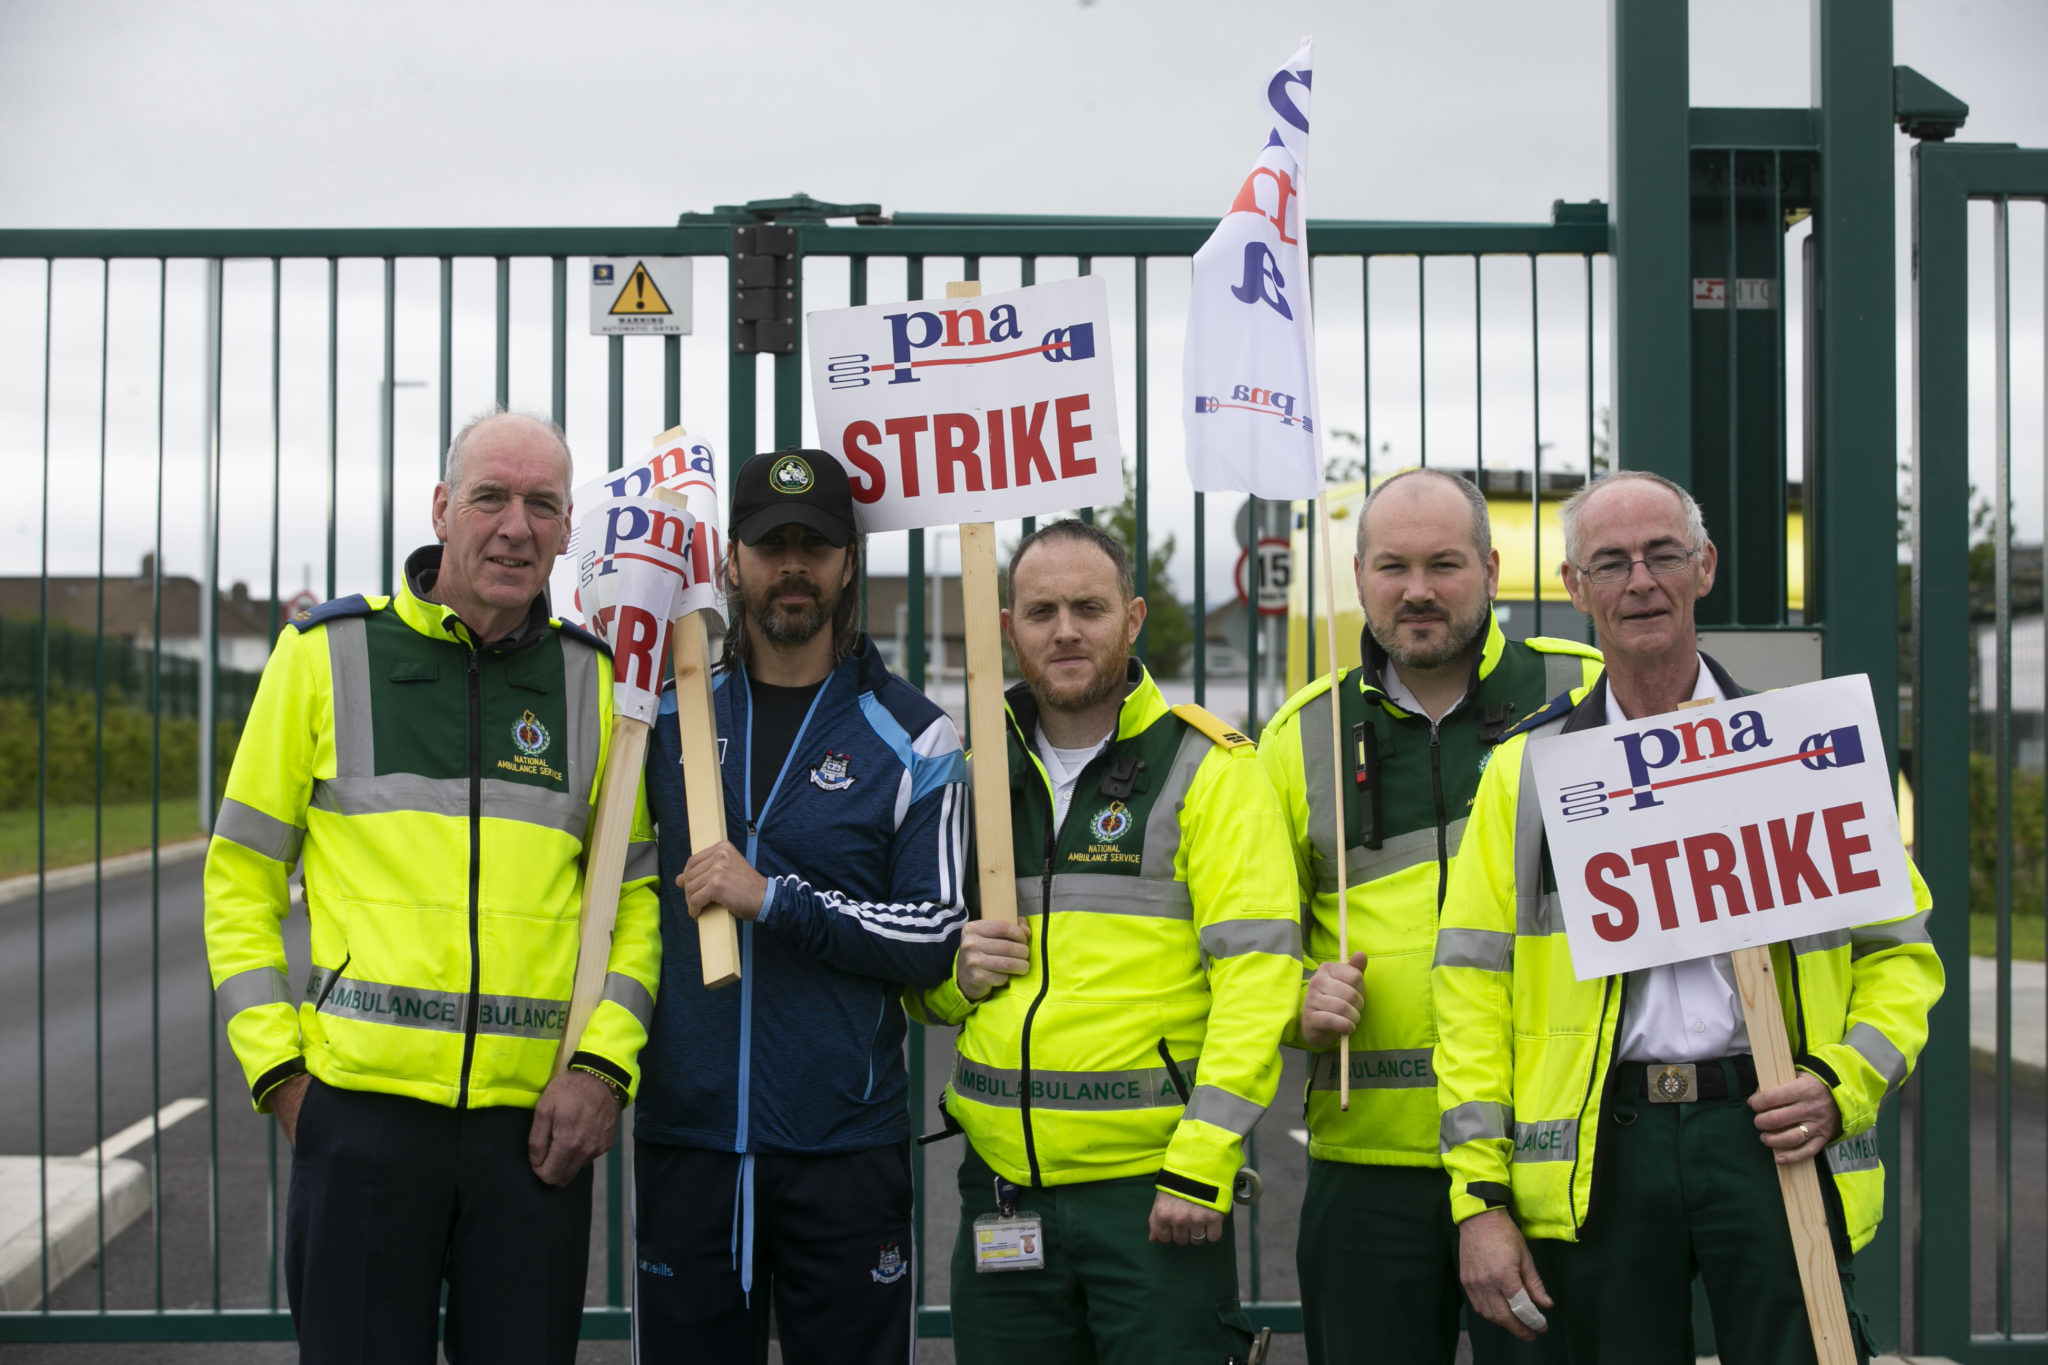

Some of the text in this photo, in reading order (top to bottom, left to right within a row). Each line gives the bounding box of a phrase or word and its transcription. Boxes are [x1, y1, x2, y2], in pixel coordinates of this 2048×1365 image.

[618, 317, 664, 325] WARNING
[883, 303, 1023, 385] pna
[843, 393, 1098, 504] STRIKE
[1258, 553, 1291, 588] 15
[497, 760, 562, 780] AMBULANCE SERVICE
[514, 755, 548, 767] NATIONAL
[1614, 710, 1773, 811] pna
[1068, 853, 1140, 863] AMBULANCE SERVICE
[1088, 844, 1121, 853] NATIONAL
[1584, 801, 1881, 942] STRIKE
[325, 987, 456, 1023] AMBULANCE
